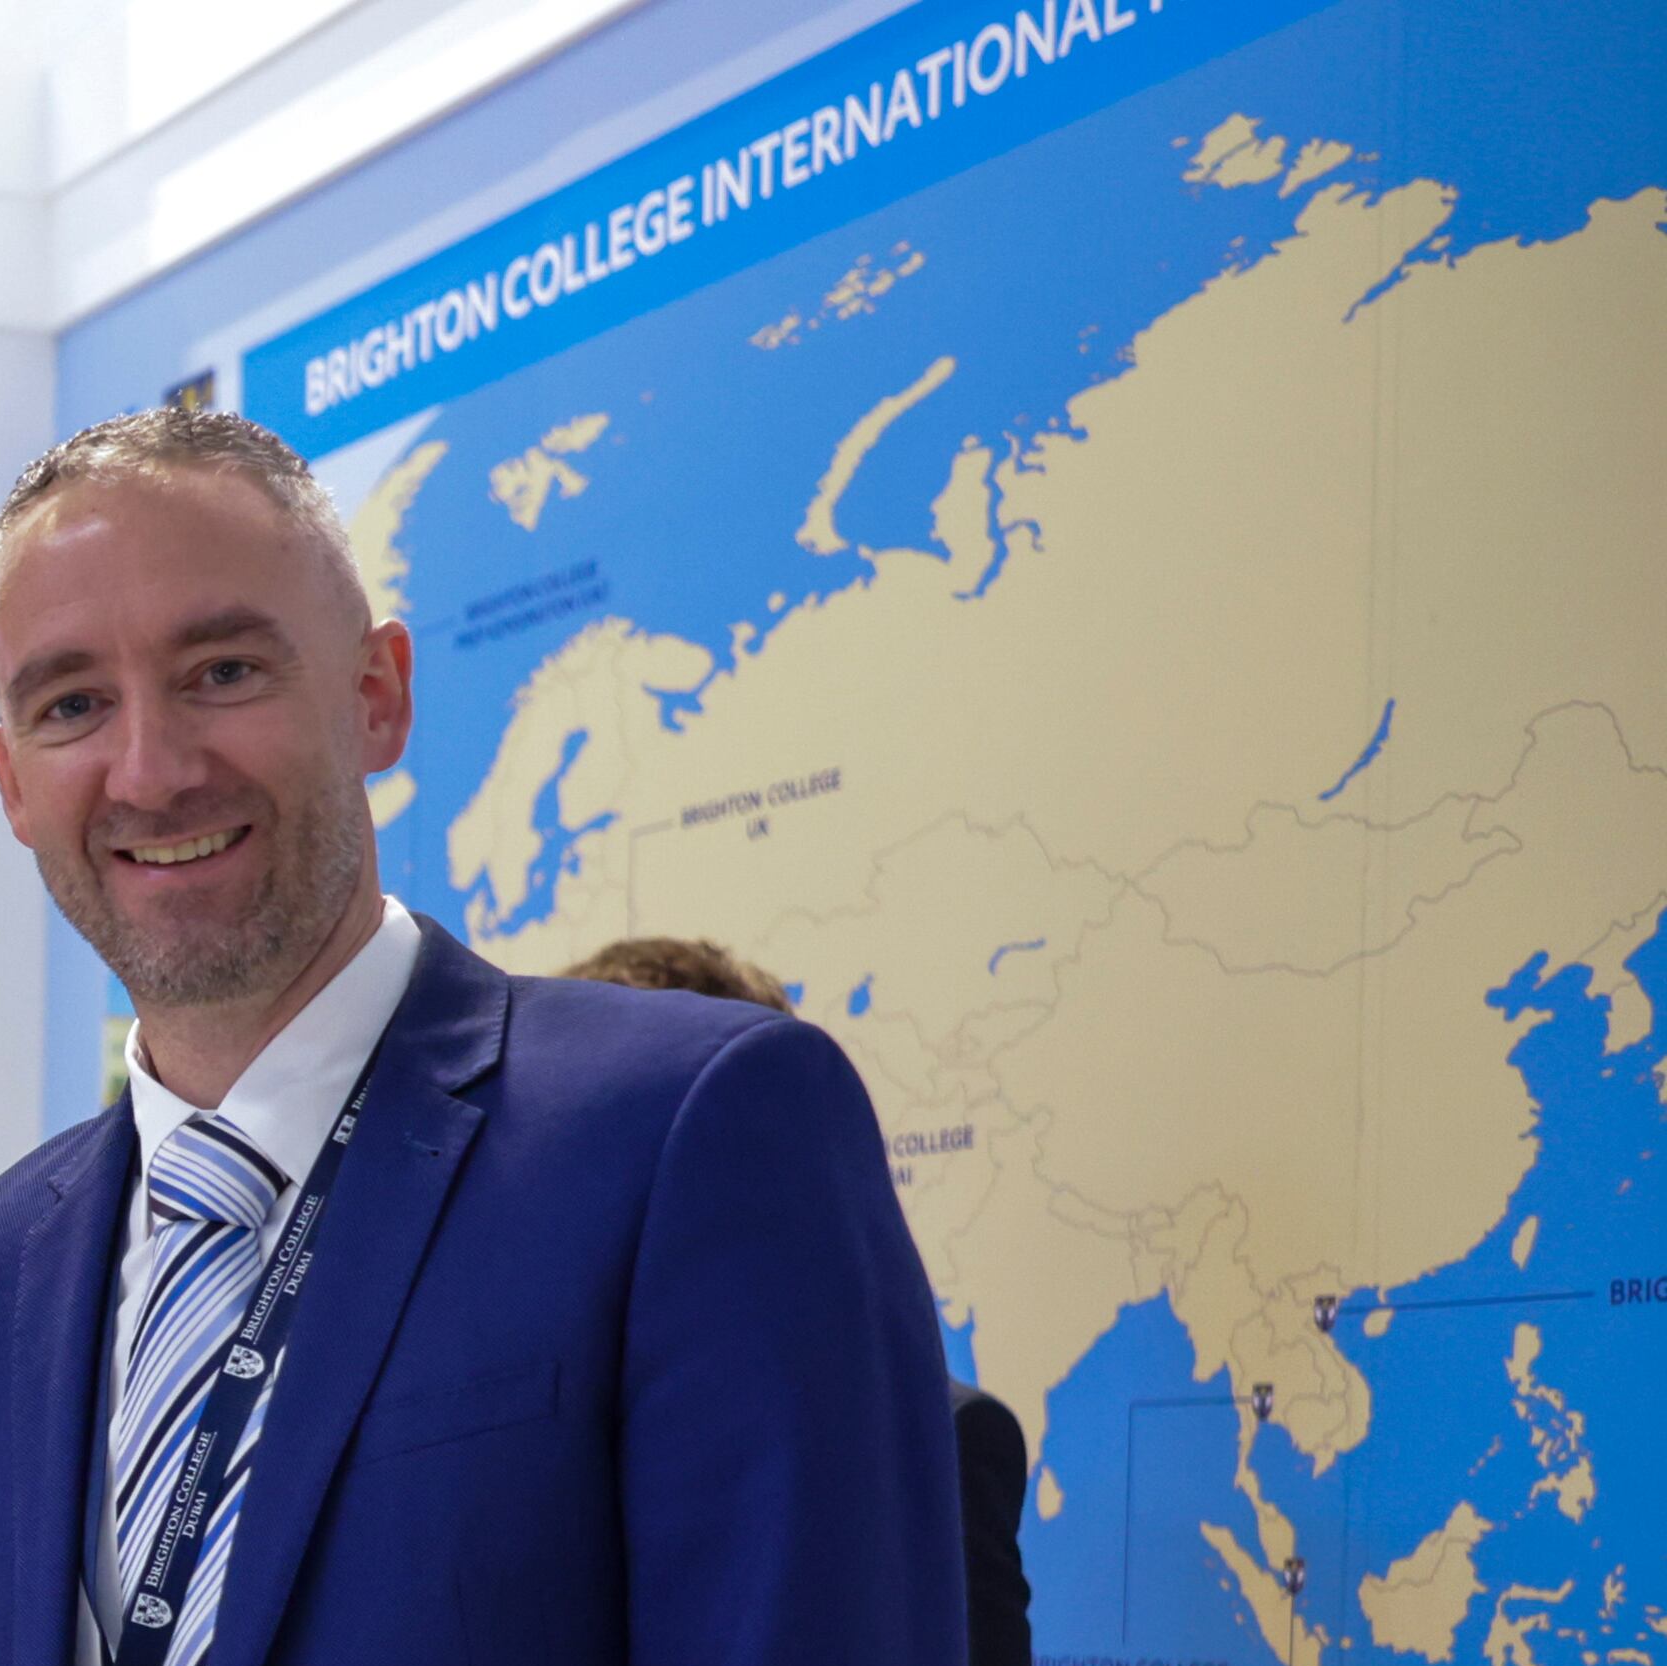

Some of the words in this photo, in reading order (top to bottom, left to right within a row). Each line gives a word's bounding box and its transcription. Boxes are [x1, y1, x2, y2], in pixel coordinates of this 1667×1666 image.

[304, 271, 498, 417] BRIGHTON
[503, 175, 695, 319] COLLEGE
[240, 1264, 285, 1341] BRIGHTON
[278, 1194, 319, 1262] COLLEGE
[283, 1251, 313, 1296] DUBAI
[144, 1506, 183, 1588] BRIGHTON
[176, 1431, 212, 1503] COLLEGE
[182, 1491, 208, 1539] DUBAI
